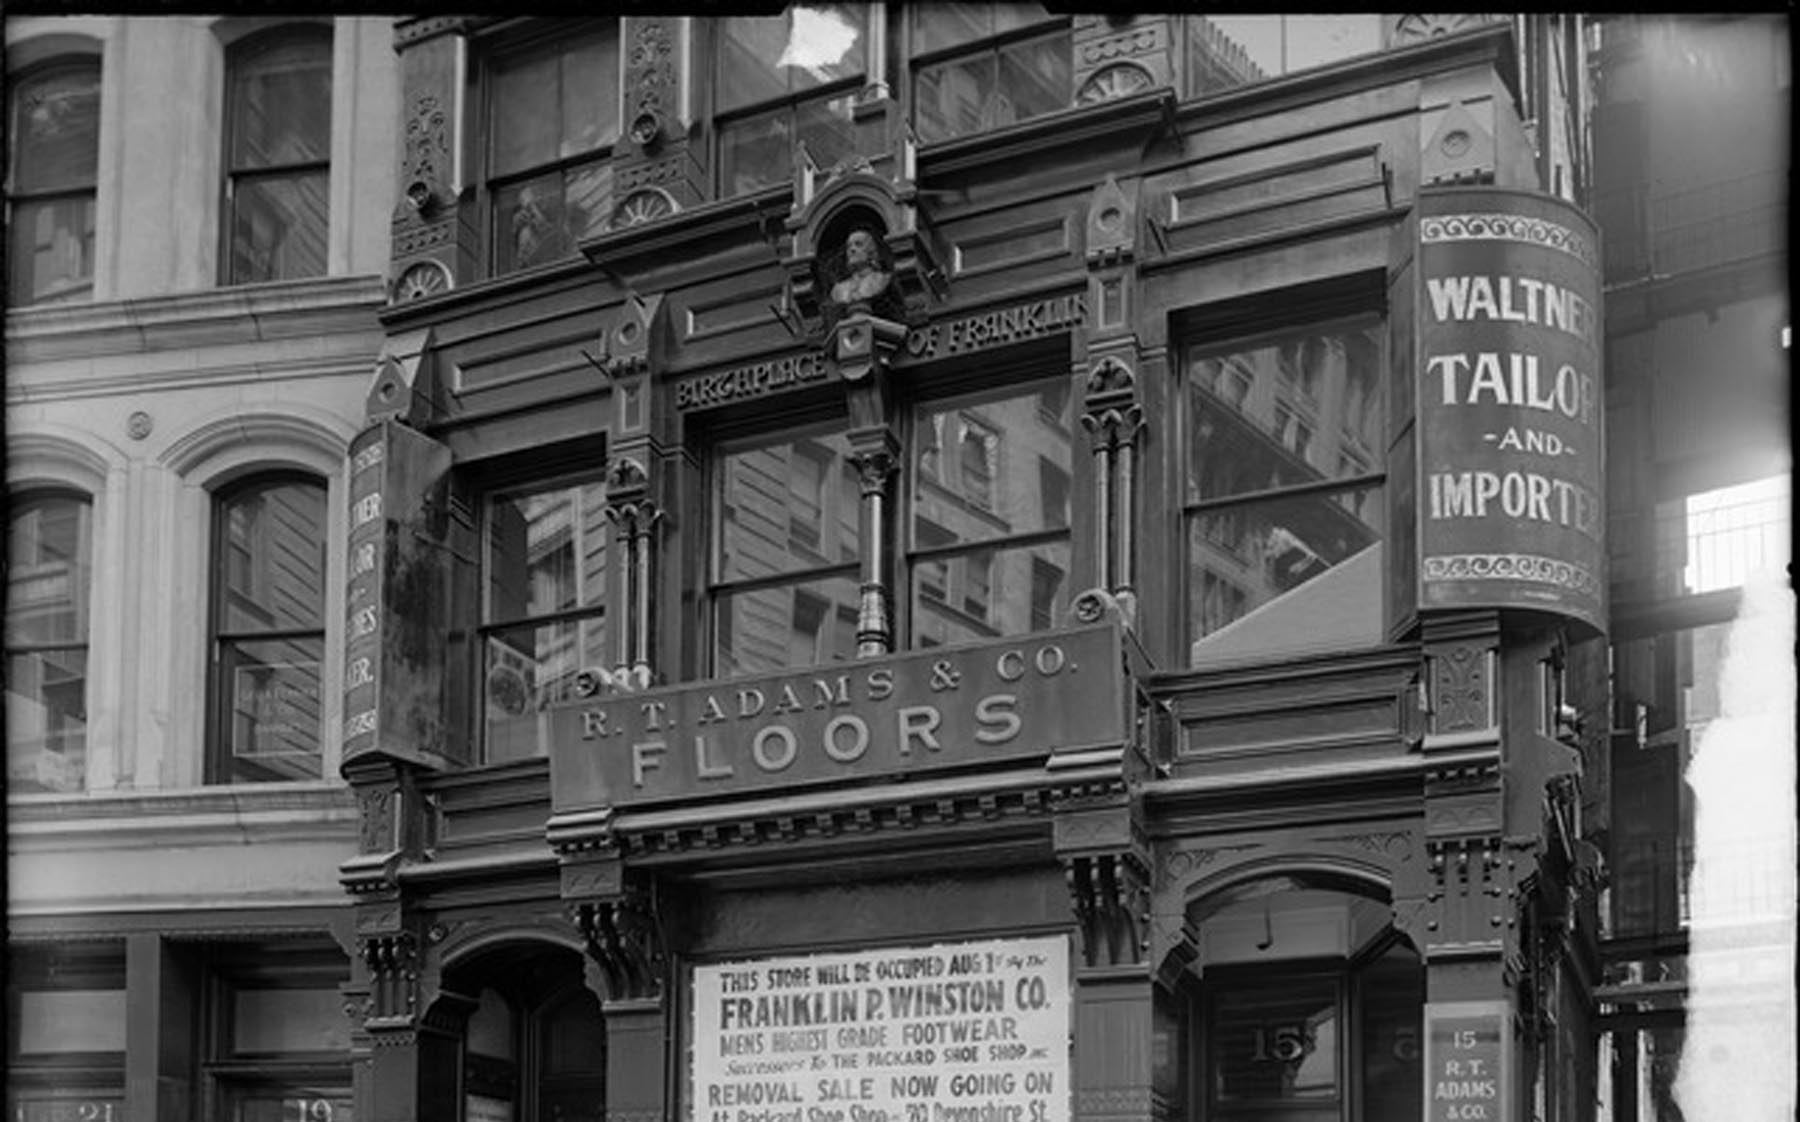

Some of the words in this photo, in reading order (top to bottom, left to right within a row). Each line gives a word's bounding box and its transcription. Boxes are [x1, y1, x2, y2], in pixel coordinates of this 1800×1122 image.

[676, 351, 826, 406] BIRTHPLACE
[907, 324, 940, 355] OF
[949, 293, 1088, 347] FRANKLIN
[581, 709, 622, 740] R.
[641, 702, 677, 733] T.
[697, 668, 895, 725] ADAMS
[929, 659, 961, 692] &
[996, 643, 1079, 682] CO.
[632, 693, 1022, 789] FLOORS
[720, 970, 759, 993] THIS
[767, 966, 811, 990] STORE
[817, 963, 852, 986] WILL
[876, 956, 944, 981] OCCUPIED
[720, 989, 859, 1030] FRANKLIN
[865, 987, 885, 1021] P.
[888, 979, 1005, 1019] WINSTON
[1015, 975, 1051, 1012] CO.
[720, 1032, 764, 1057] MENS
[837, 1026, 888, 1049] GRADE
[903, 1017, 1018, 1046] FOOTWEAR
[1254, 1026, 1303, 1062] 15
[1454, 1030, 1477, 1049] 15
[831, 1052, 858, 1069] THE
[867, 1049, 936, 1068] PACKARD
[943, 1045, 979, 1063] SHOE
[989, 1043, 1027, 1062] SHOP
[708, 1081, 804, 1107] REMOVAL
[817, 1077, 875, 1103] SALE
[890, 1075, 939, 1099] NOW
[949, 1073, 1017, 1097] GOING
[1024, 1071, 1054, 1095] ON
[1434, 1081, 1496, 1100] ADAMS
